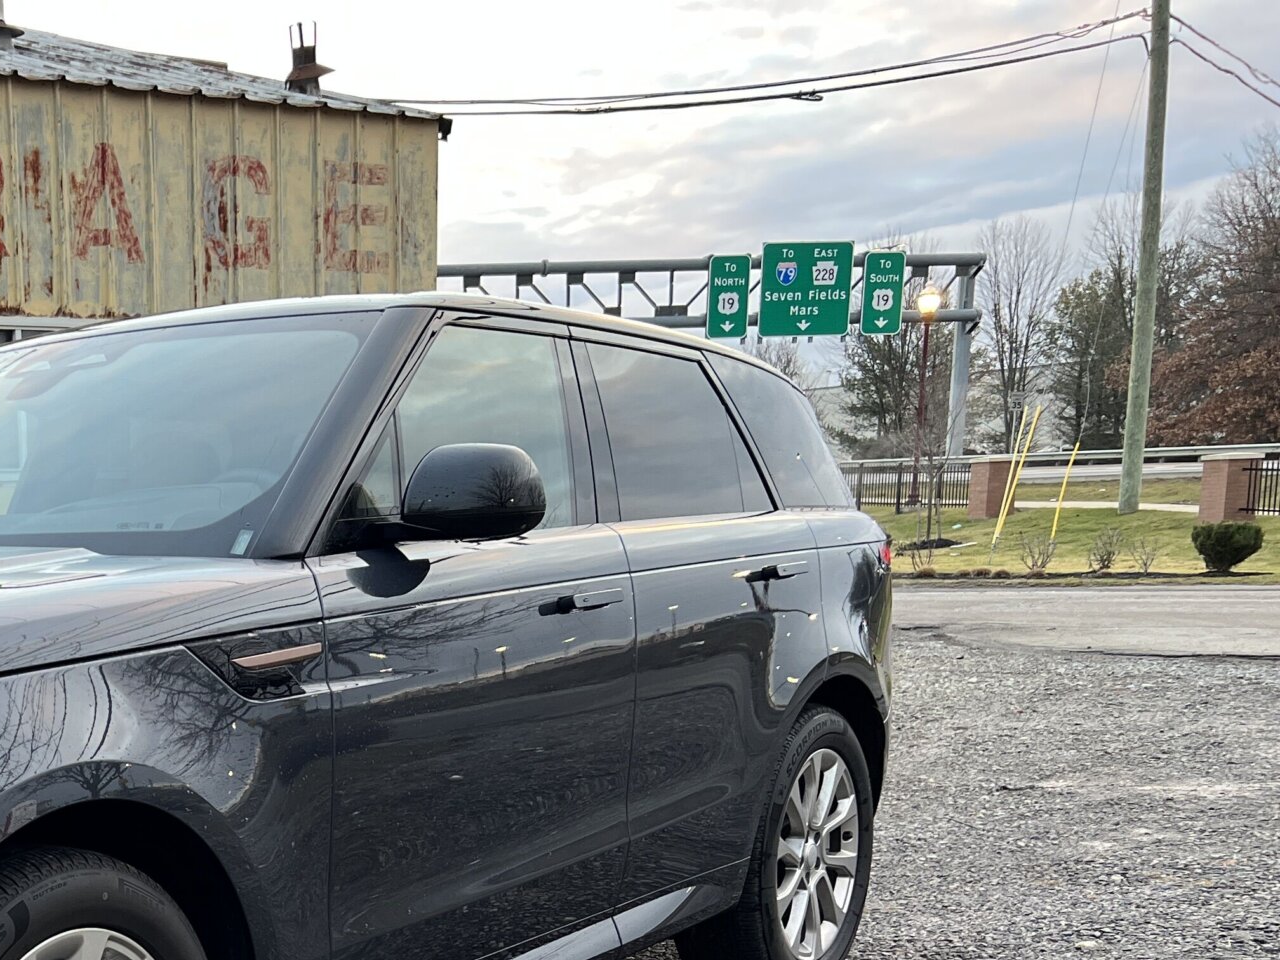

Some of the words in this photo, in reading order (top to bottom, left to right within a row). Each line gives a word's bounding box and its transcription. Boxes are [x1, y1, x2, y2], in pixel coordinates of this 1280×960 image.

[814, 248, 838, 258] EAST
[778, 268, 796, 281] 79
[814, 268, 835, 281] 228
[869, 273, 900, 283] SOUTH
[714, 277, 745, 287] NORTH
[764, 291, 802, 302] Seven
[808, 288, 847, 300] Fields
[876, 294, 890, 307] 19
[721, 297, 735, 311] 19
[789, 305, 819, 316] Mars
[1011, 401, 1022, 409] 35
